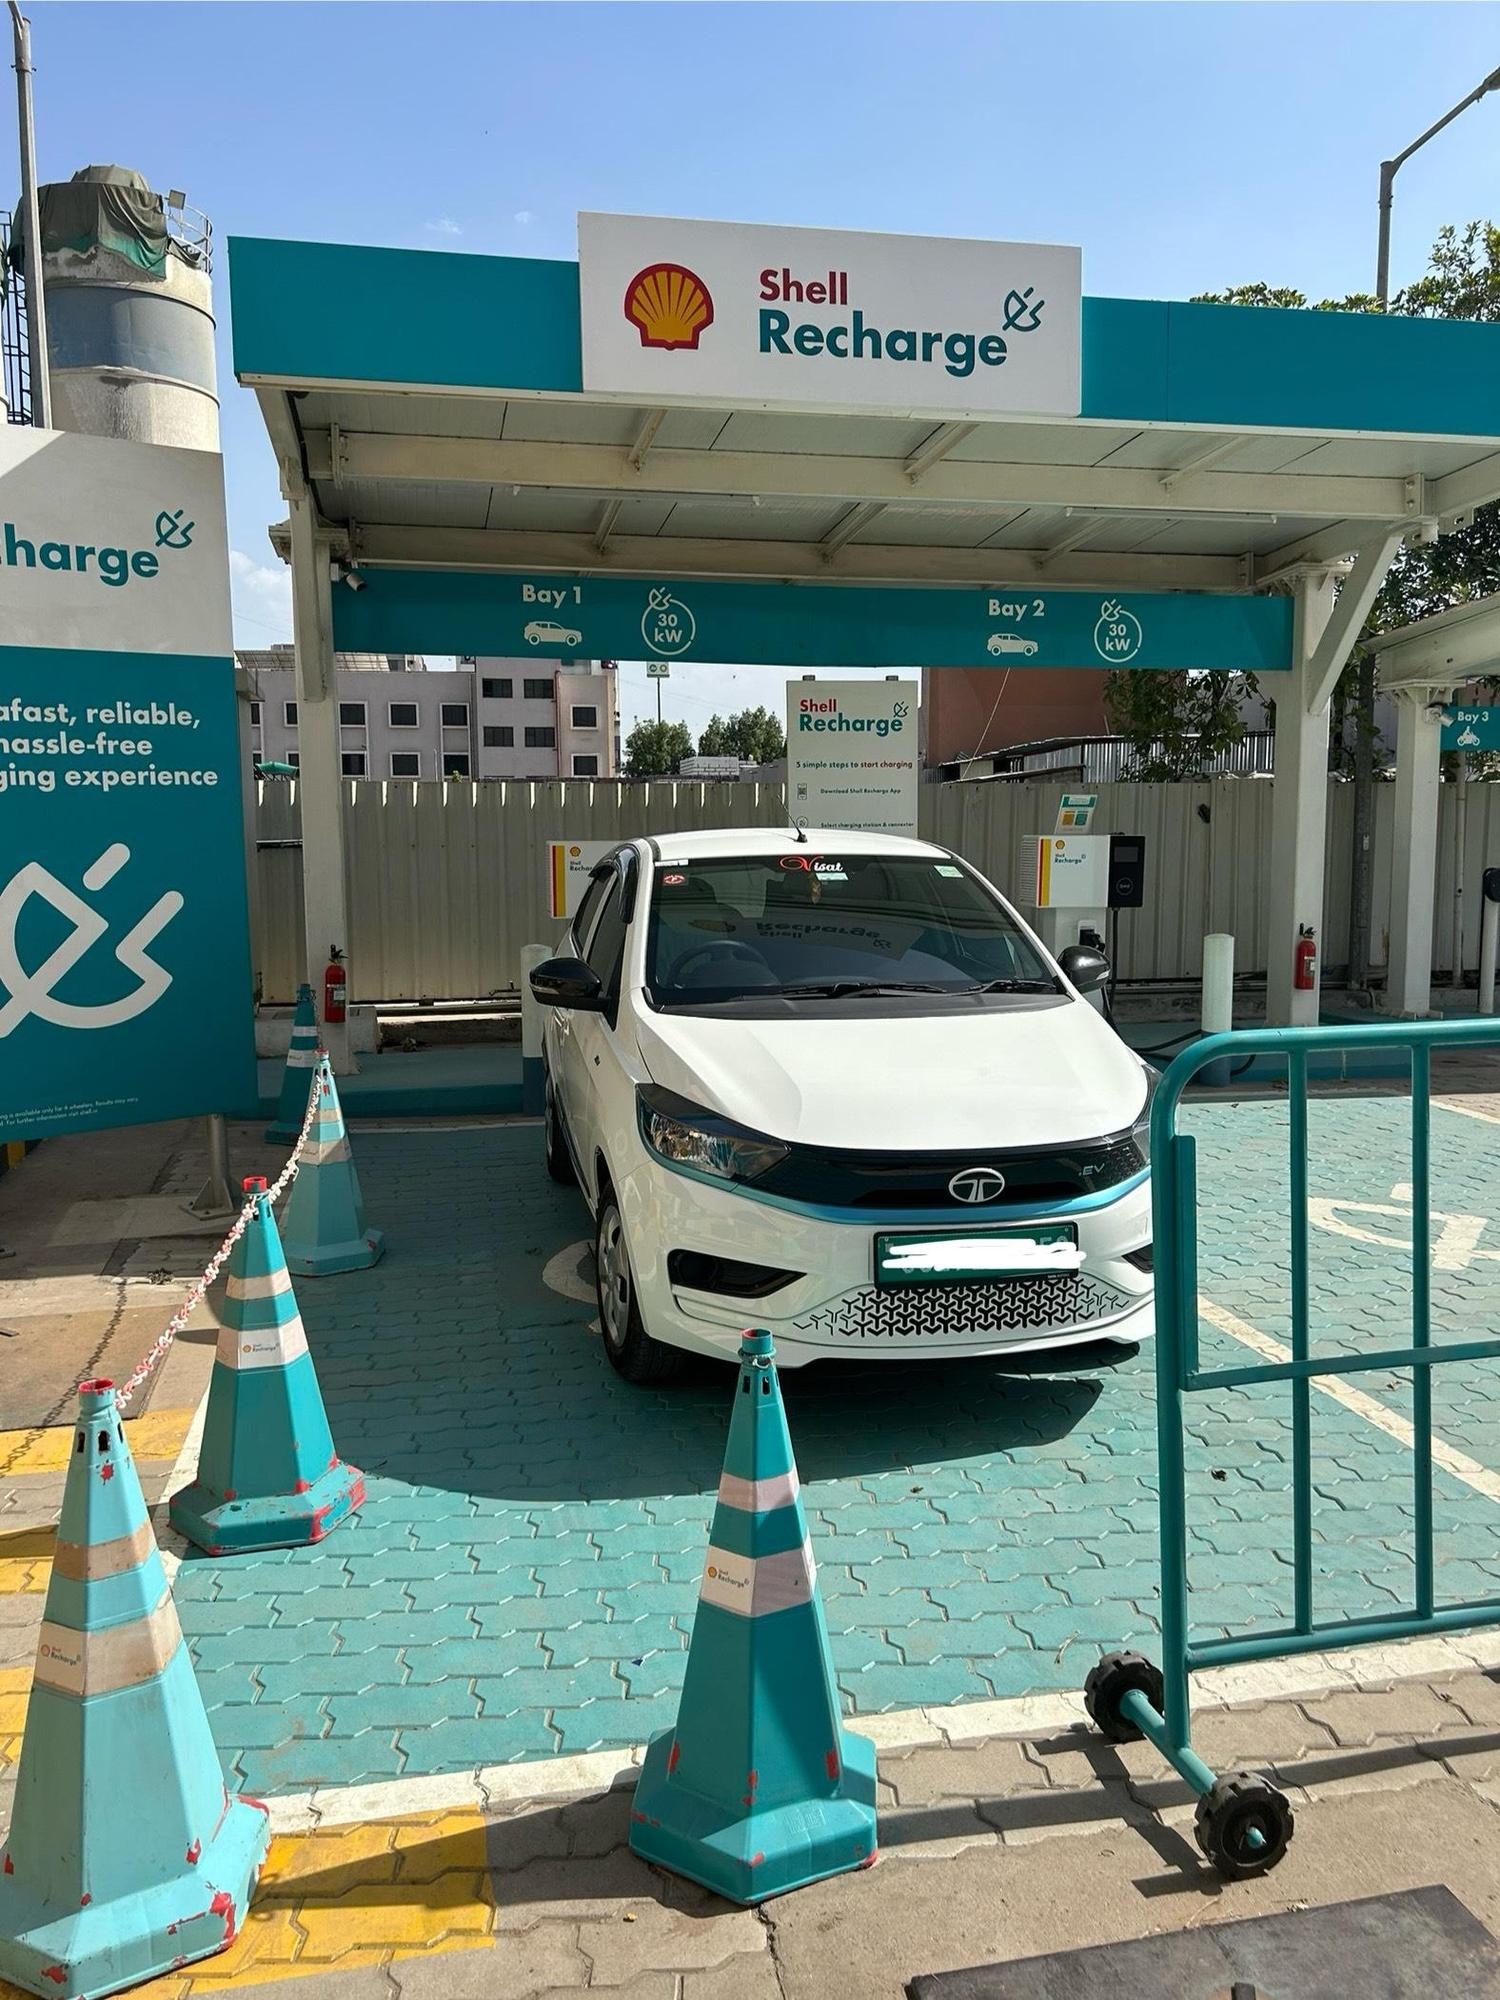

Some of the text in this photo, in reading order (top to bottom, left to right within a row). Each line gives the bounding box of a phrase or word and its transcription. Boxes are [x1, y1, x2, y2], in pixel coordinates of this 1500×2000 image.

[759, 268, 848, 306] Shell
[759, 308, 1008, 377] Recharge
[0, 522, 159, 587] harge
[522, 584, 582, 608] Bay 1
[988, 599, 1045, 621] Bay 2
[657, 613, 678, 627] 30
[653, 627, 682, 643] kW
[1109, 623, 1127, 636] 30
[1105, 637, 1131, 651] kW
[800, 699, 837, 713] Shell
[86, 701, 200, 729] reliable,
[1457, 711, 1489, 724] Bay 3
[799, 712, 903, 737] Recharge
[803, 761, 827, 770] simple
[829, 761, 849, 770] steps
[880, 761, 913, 770] charging
[64, 764, 218, 791] experience
[863, 787, 889, 795] Recharge
[780, 855, 844, 872] Visat
